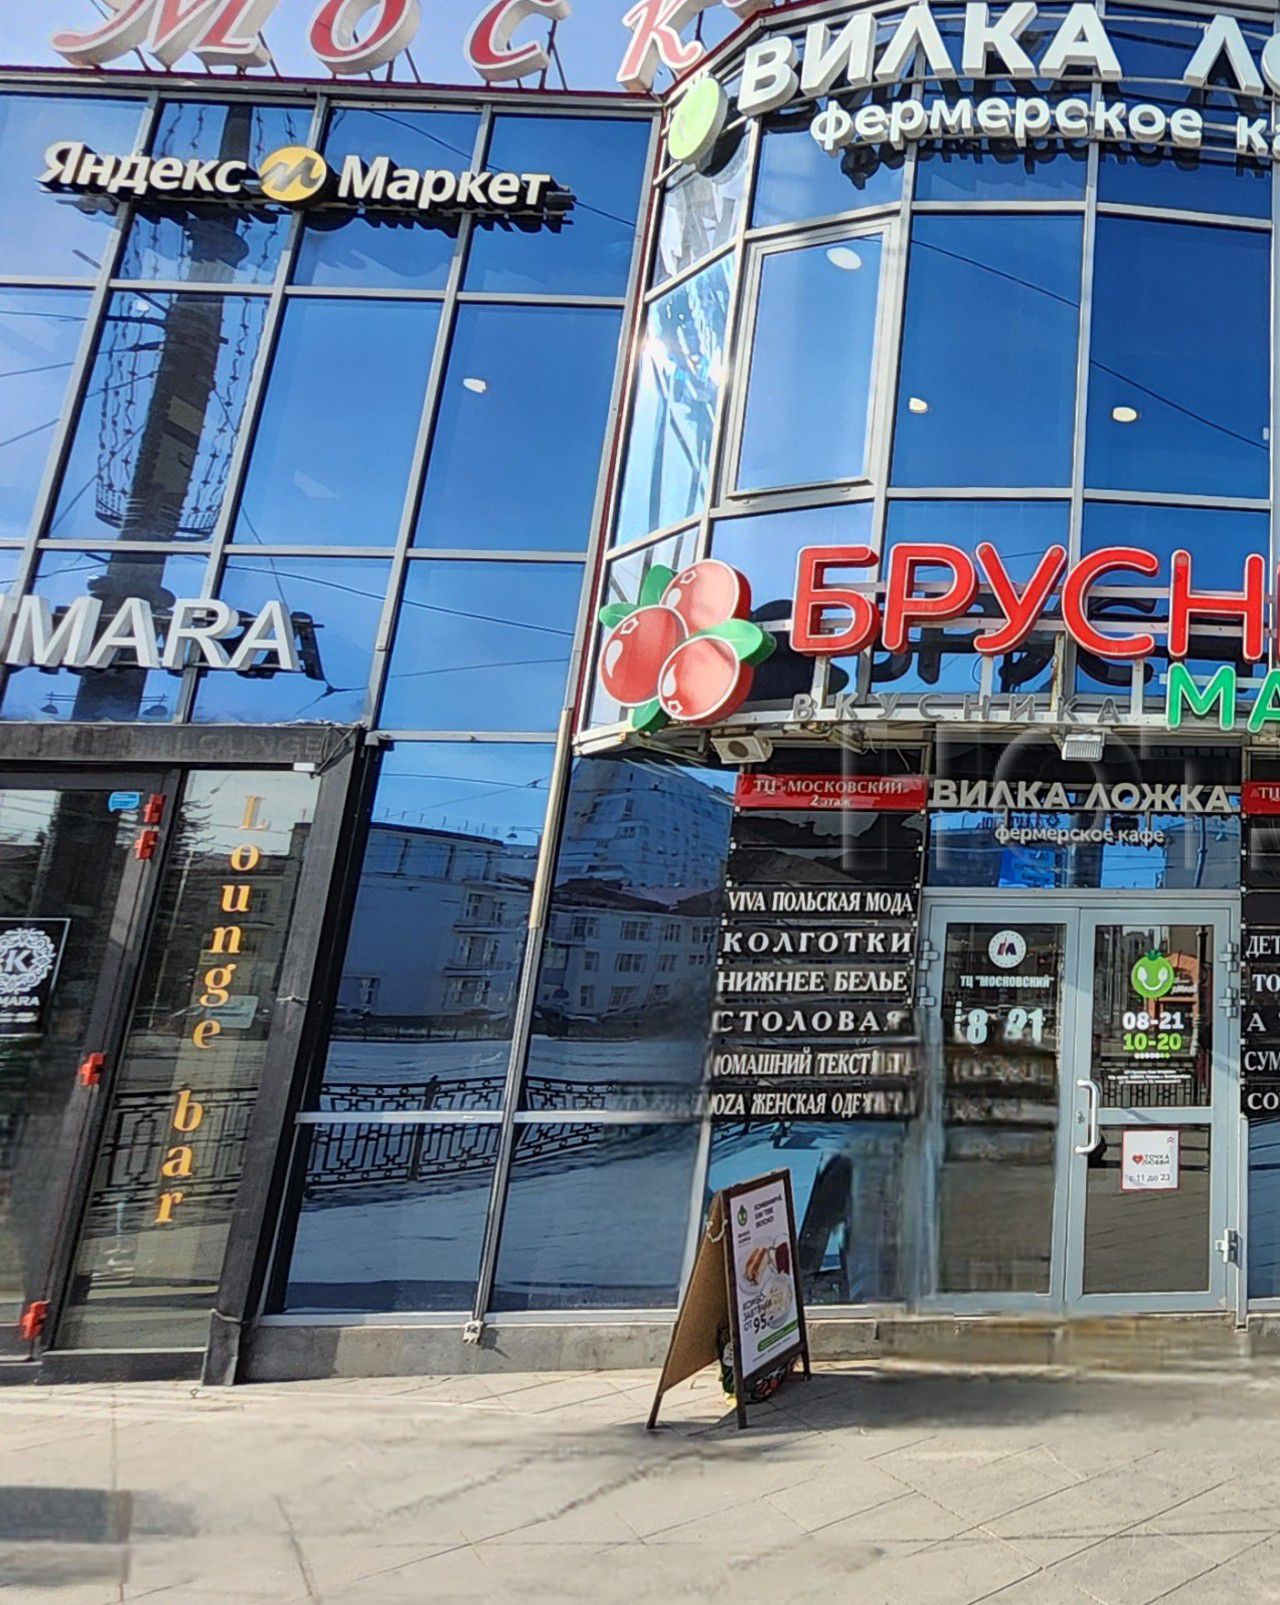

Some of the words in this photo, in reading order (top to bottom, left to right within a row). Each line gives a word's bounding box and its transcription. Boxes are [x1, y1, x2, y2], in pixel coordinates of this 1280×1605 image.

[737, 1, 1122, 116] ВИЛКА
[811, 92, 1203, 151] фермерское
[39, 141, 246, 195] Яндекс
[338, 155, 551, 208] Маркет
[0, 595, 302, 670] MARA
[793, 693, 1121, 723] ВКУСНИКА
[754, 779, 776, 795] ТЦ
[932, 779, 1076, 810] ВИЛКА
[1084, 782, 1232, 812] ЛОЖКА
[1258, 787, 1280, 801] ТЦ
[810, 795, 818, 806] 2
[995, 824, 1113, 847] фермерское
[1118, 825, 1165, 847] кафе
[729, 892, 766, 912] VIVA
[771, 891, 861, 912] ПОЛЬСКАЯ
[865, 892, 913, 918] МОДА
[192, 794, 267, 1050] Lounge
[722, 931, 912, 954] КОЛГОТКИ
[717, 971, 825, 992] НИЖНЕЕ
[834, 971, 908, 992] БЕЛЬЕ
[960, 975, 974, 989] ТЦ
[712, 1010, 905, 1032] СТОЛОВАЯ
[1122, 1011, 1185, 1030] 08-21
[1122, 1032, 1183, 1051] 10-20
[817, 1051, 914, 1076] ТЕКСТ
[751, 1092, 826, 1116] ЖЕНСКАЯ
[154, 1089, 203, 1224] bar
